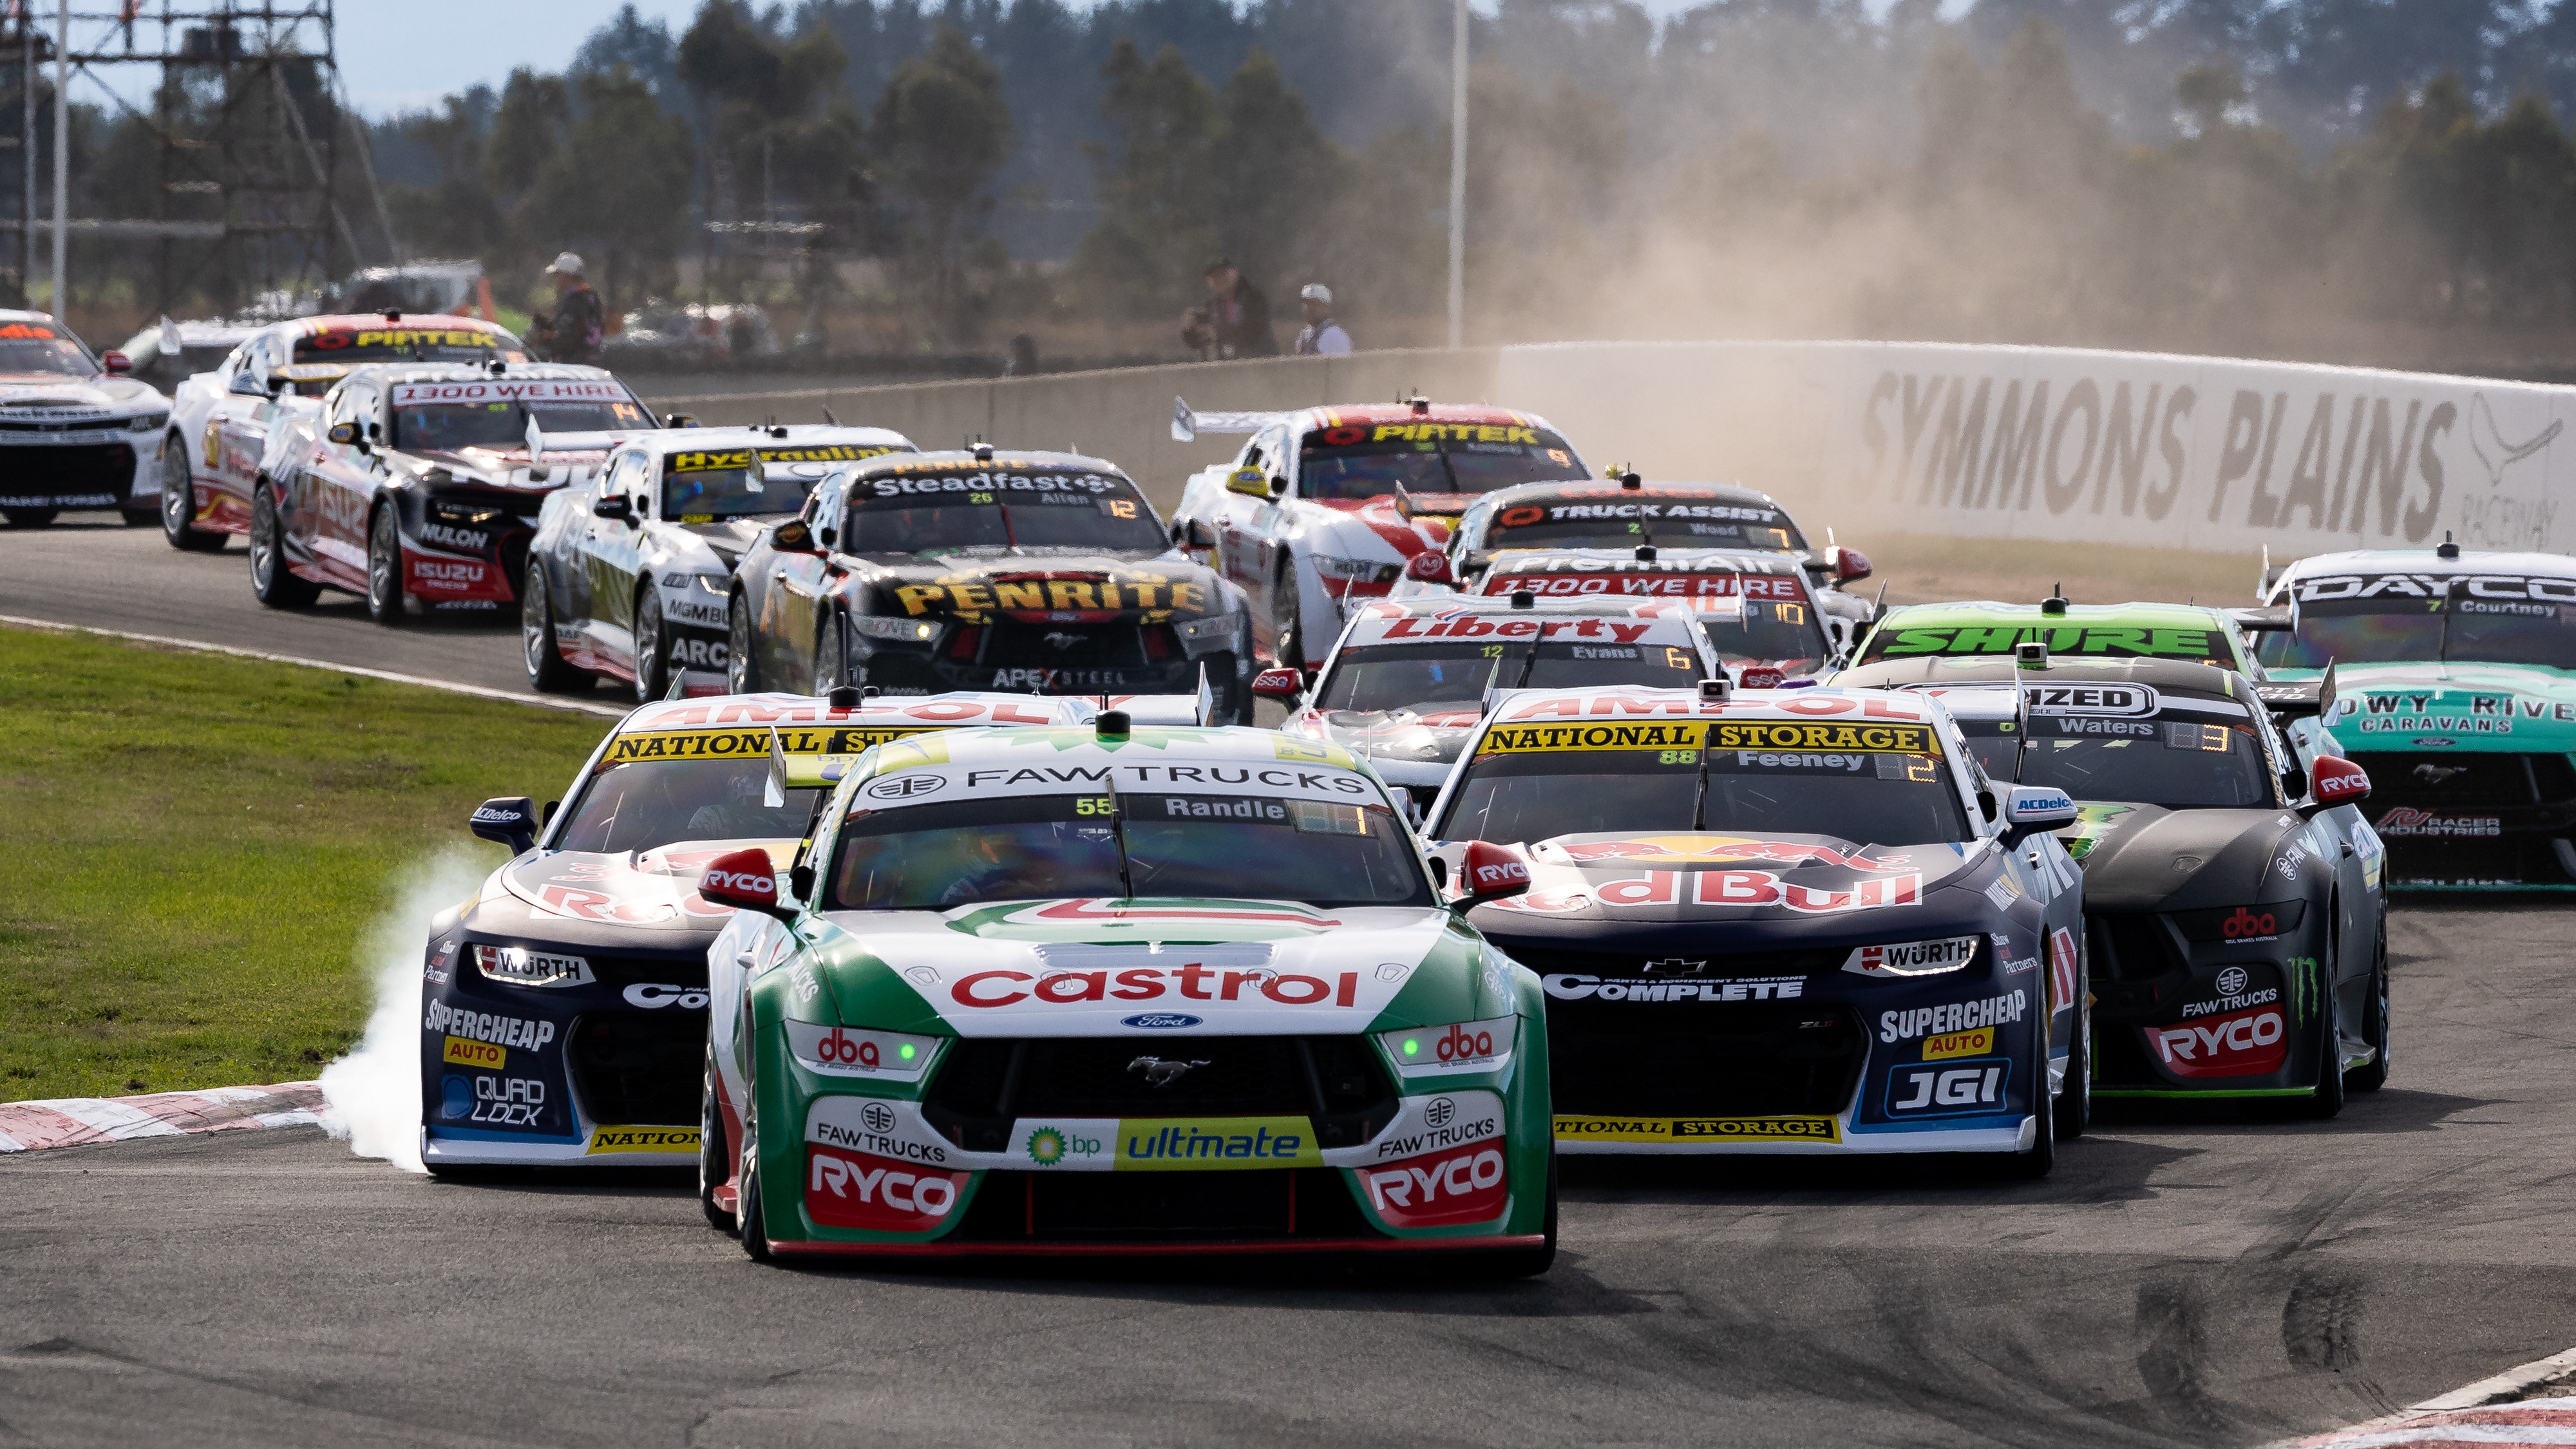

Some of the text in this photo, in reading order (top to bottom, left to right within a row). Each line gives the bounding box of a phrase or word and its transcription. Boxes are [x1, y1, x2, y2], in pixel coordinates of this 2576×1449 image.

[401, 384, 623, 401] 1300 WE HIRE
[1373, 424, 1539, 446] PIRTEK
[1855, 372, 2456, 544] SYMMONS PLAINS
[873, 472, 1074, 497] Steadfast
[1109, 499, 1138, 519] 12
[1549, 505, 1779, 522] TRUCK ASSIST
[421, 523, 488, 548] NULON
[414, 562, 484, 582] ISUZU
[894, 580, 1205, 617] PENRITE
[1495, 578, 1795, 596] 1300 WE HIRE
[2299, 575, 2576, 602] DAYCO
[1776, 603, 1804, 625] 10
[2427, 600, 2557, 618] 7 Courtney
[1381, 616, 1651, 643] Liberty
[671, 638, 730, 668] ARC
[1573, 647, 1637, 660] Evans
[1665, 647, 1691, 670] 6
[993, 668, 1126, 690] APEX STEEL
[1488, 726, 1695, 752] NATIONAL
[1719, 725, 1920, 752] STORAGE
[2058, 718, 2154, 736] Waters
[2202, 724, 2228, 752] 3
[2360, 716, 2512, 734] CARAVANS
[616, 732, 820, 759] NATIONAL
[1659, 750, 1864, 772] 88 Feeney
[1907, 754, 1936, 783] 2
[968, 766, 1365, 794] FAW TRUCKS
[1076, 798, 1285, 820] 55 Randle
[2018, 797, 2072, 810] ACDelc
[705, 870, 773, 893] RYCO
[1697, 870, 1921, 909] Bull
[2223, 907, 2275, 938] dba
[1888, 939, 1971, 967] WÜRTH
[1990, 932, 2011, 947] Shaw
[2003, 957, 2038, 974] Partners
[951, 962, 1358, 1009] castrol
[1542, 973, 1804, 1001] COMPLETE
[2183, 987, 2278, 1018] FAW TRUCKS
[425, 998, 555, 1052] SUPERCHEAP
[1880, 989, 2027, 1044] SUPERCHEAP
[818, 1028, 880, 1066] dba
[1436, 1025, 1493, 1061] dba
[1929, 1034, 1987, 1053] AUTO
[2159, 1012, 2284, 1063] RYCO
[449, 1043, 500, 1062] AUTO
[476, 1075, 545, 1104] QUAD
[1896, 1068, 2000, 1110] JGI
[471, 1103, 544, 1126] LOCK
[818, 1122, 945, 1162] FAW TRUCKS
[1072, 1125, 1302, 1159] bp ultimate
[1378, 1117, 1495, 1158] FAW TRUCKS
[1682, 1120, 1828, 1138] STORAGE
[812, 1153, 956, 1216] RYCO
[1371, 1149, 1504, 1211] RYCO
